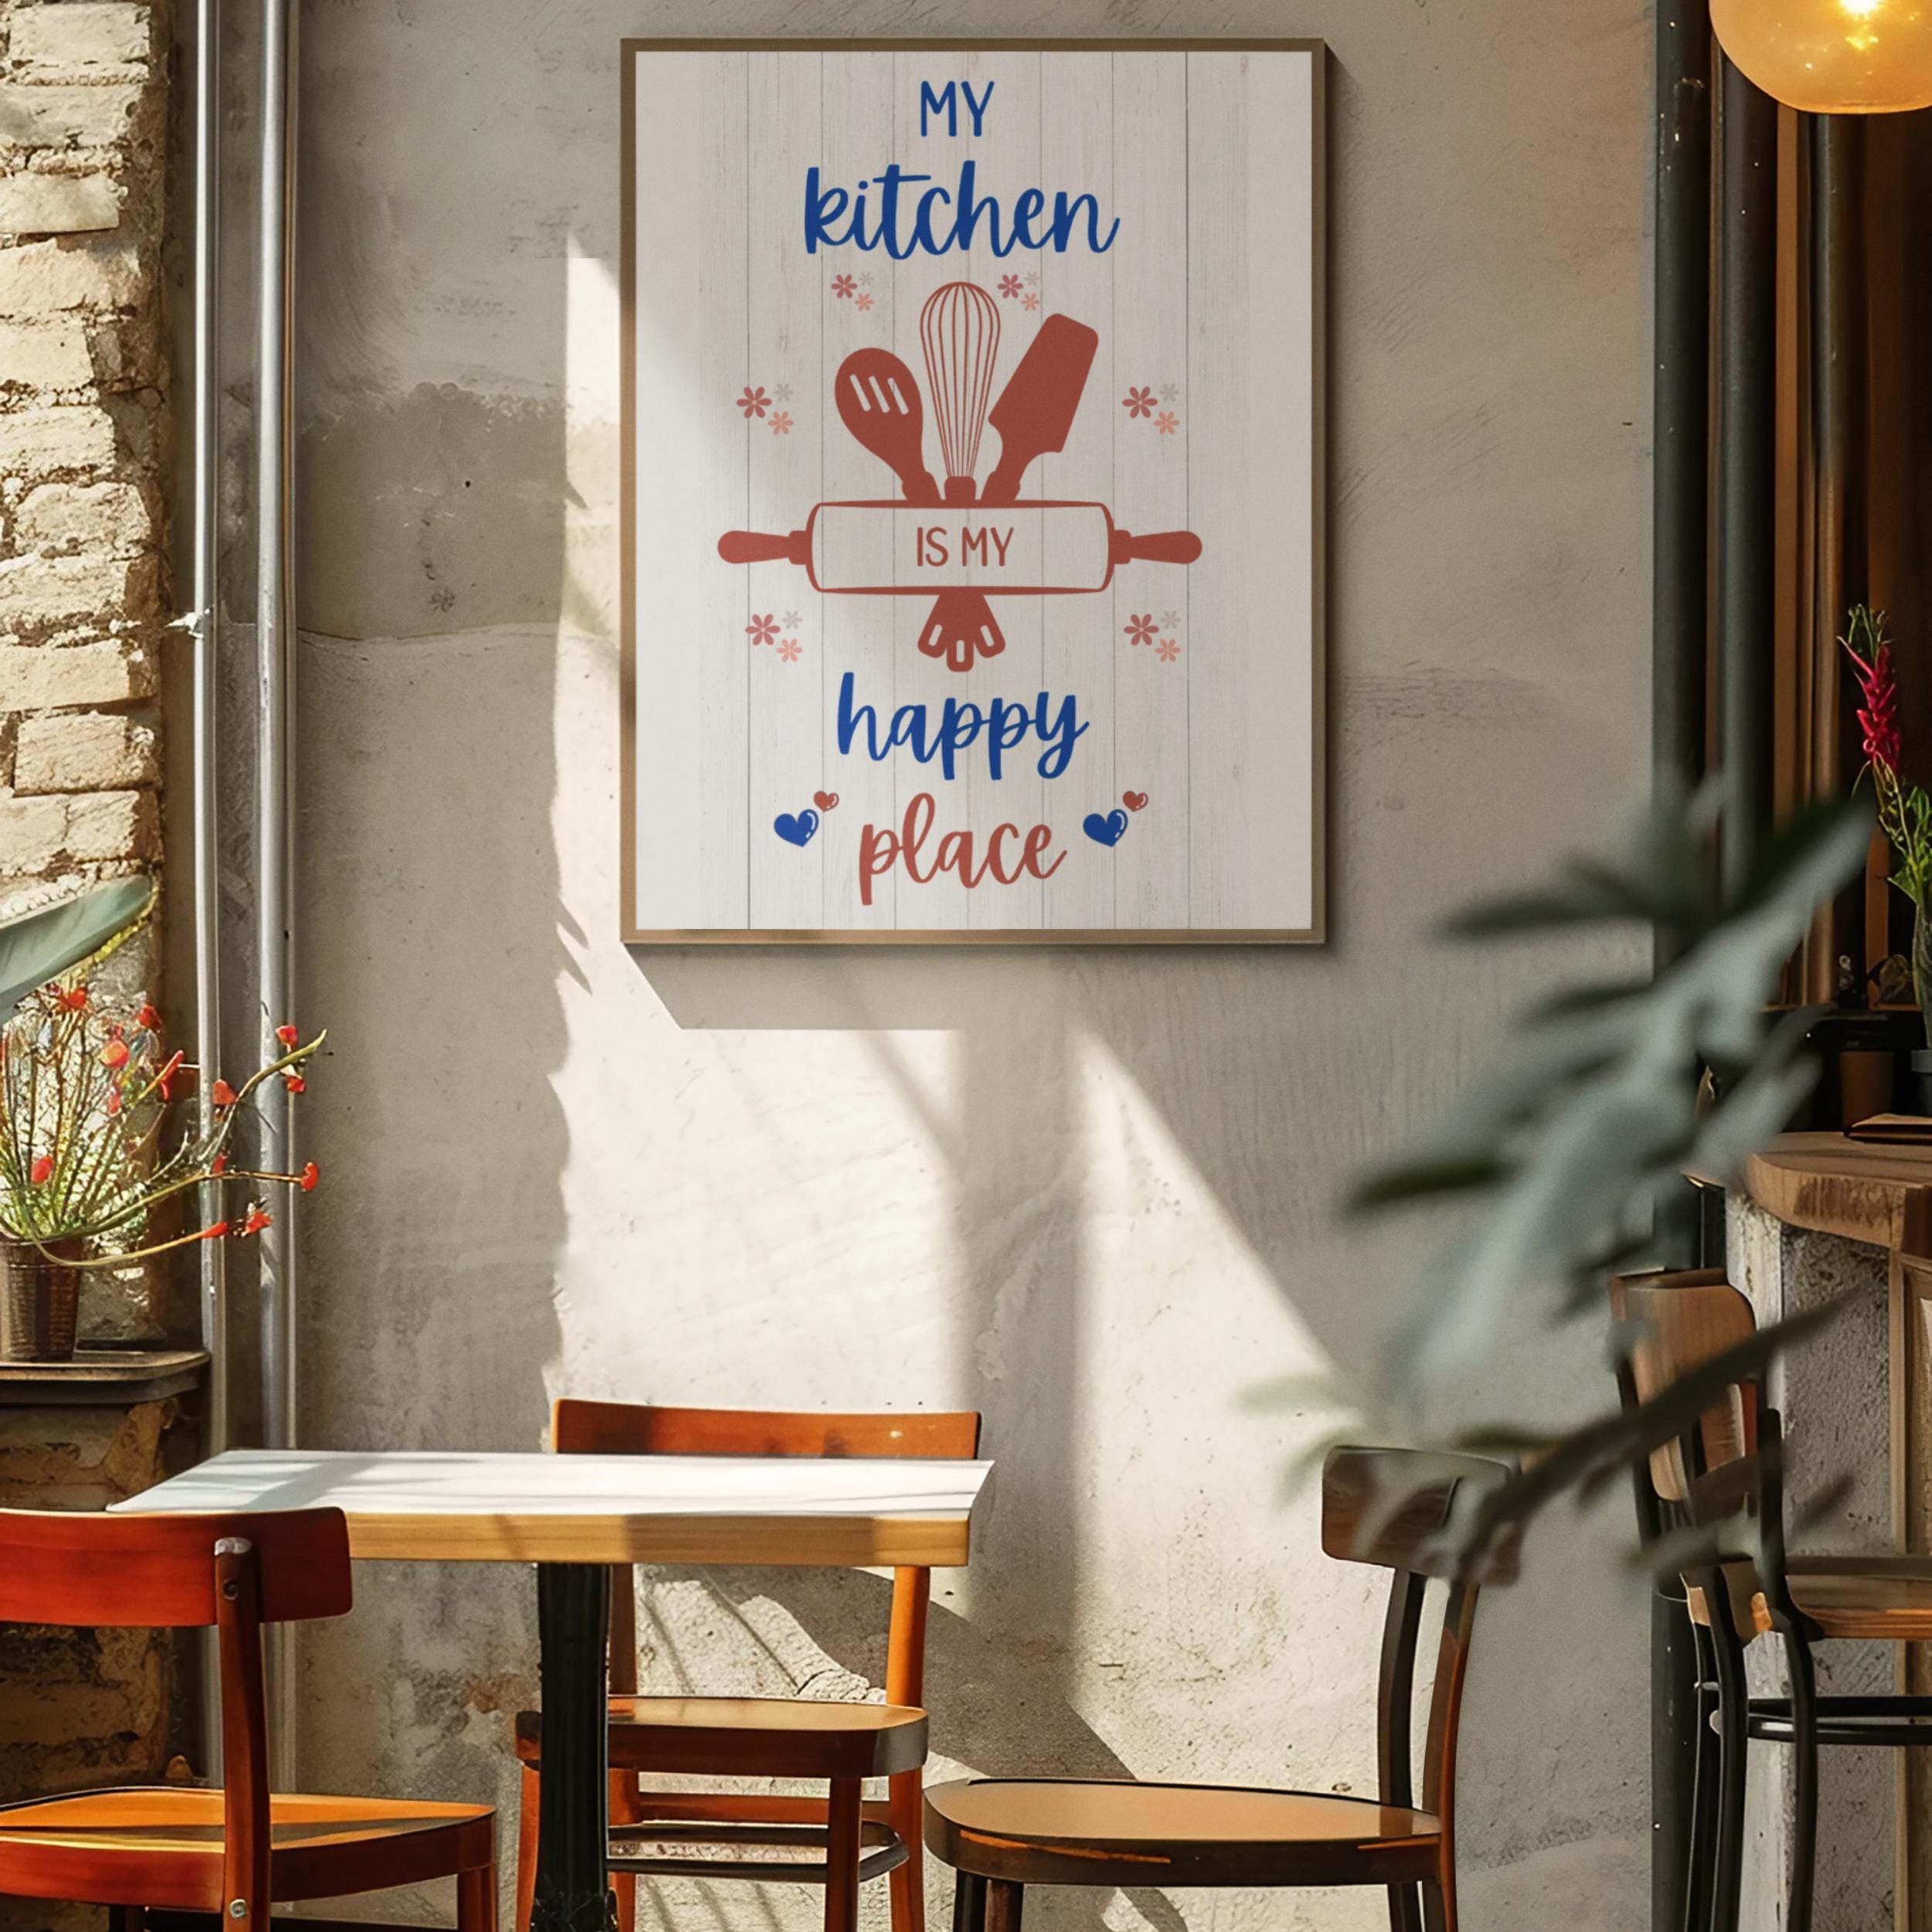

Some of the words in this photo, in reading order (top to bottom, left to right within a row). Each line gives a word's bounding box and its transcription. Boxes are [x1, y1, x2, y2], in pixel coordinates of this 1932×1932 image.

[920, 80, 995, 138] MY
[804, 160, 1121, 260] kitchen
[916, 526, 949, 567] IS
[961, 526, 1015, 567] MY
[837, 672, 1090, 781] happy
[859, 792, 1068, 906] place
